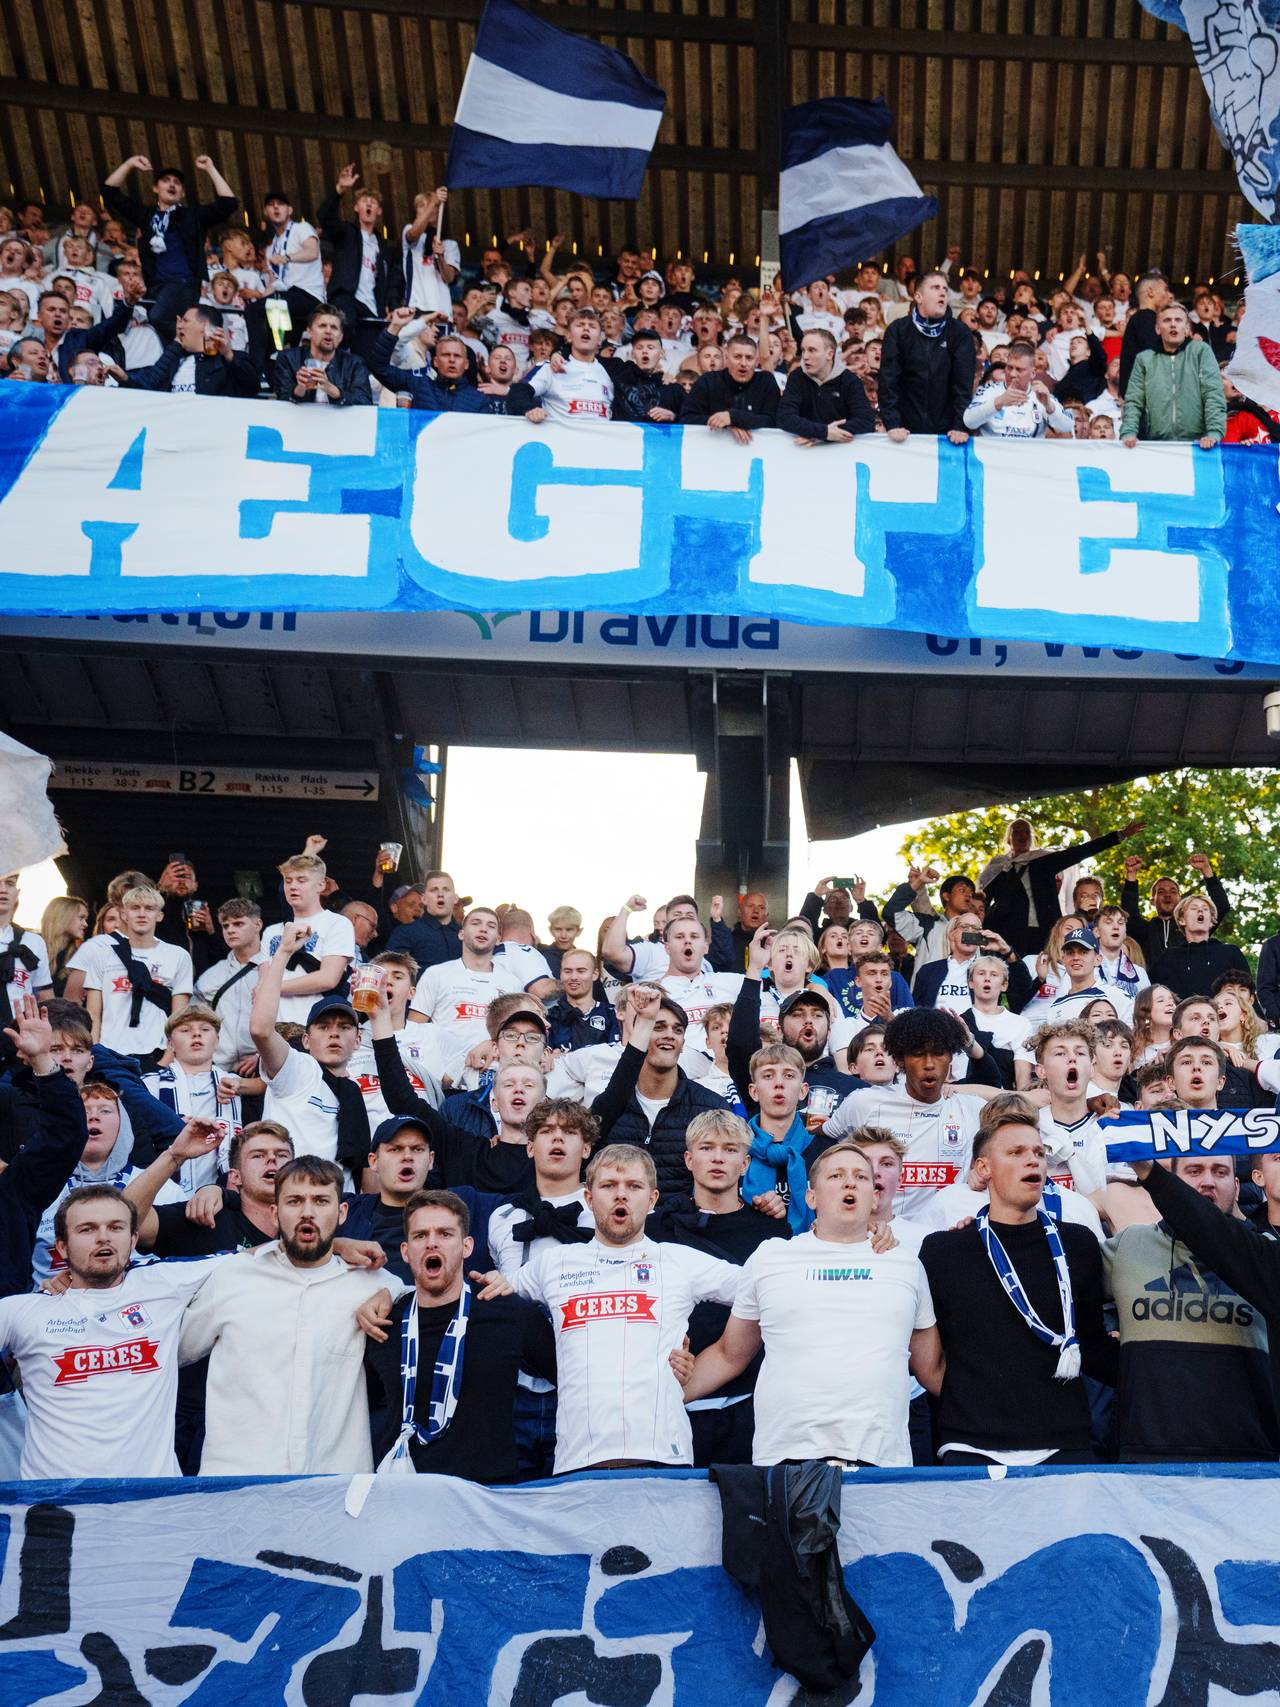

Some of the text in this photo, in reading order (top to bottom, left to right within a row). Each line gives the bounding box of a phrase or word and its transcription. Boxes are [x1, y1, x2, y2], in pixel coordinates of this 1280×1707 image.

[179, 770, 216, 792] B2
[940, 985, 967, 996] ERE
[465, 1004, 488, 1018] CER
[903, 1167, 947, 1184] ERES
[575, 1295, 638, 1317] CERES
[1132, 1290, 1255, 1327] adidas
[73, 1344, 143, 1372] CERES
